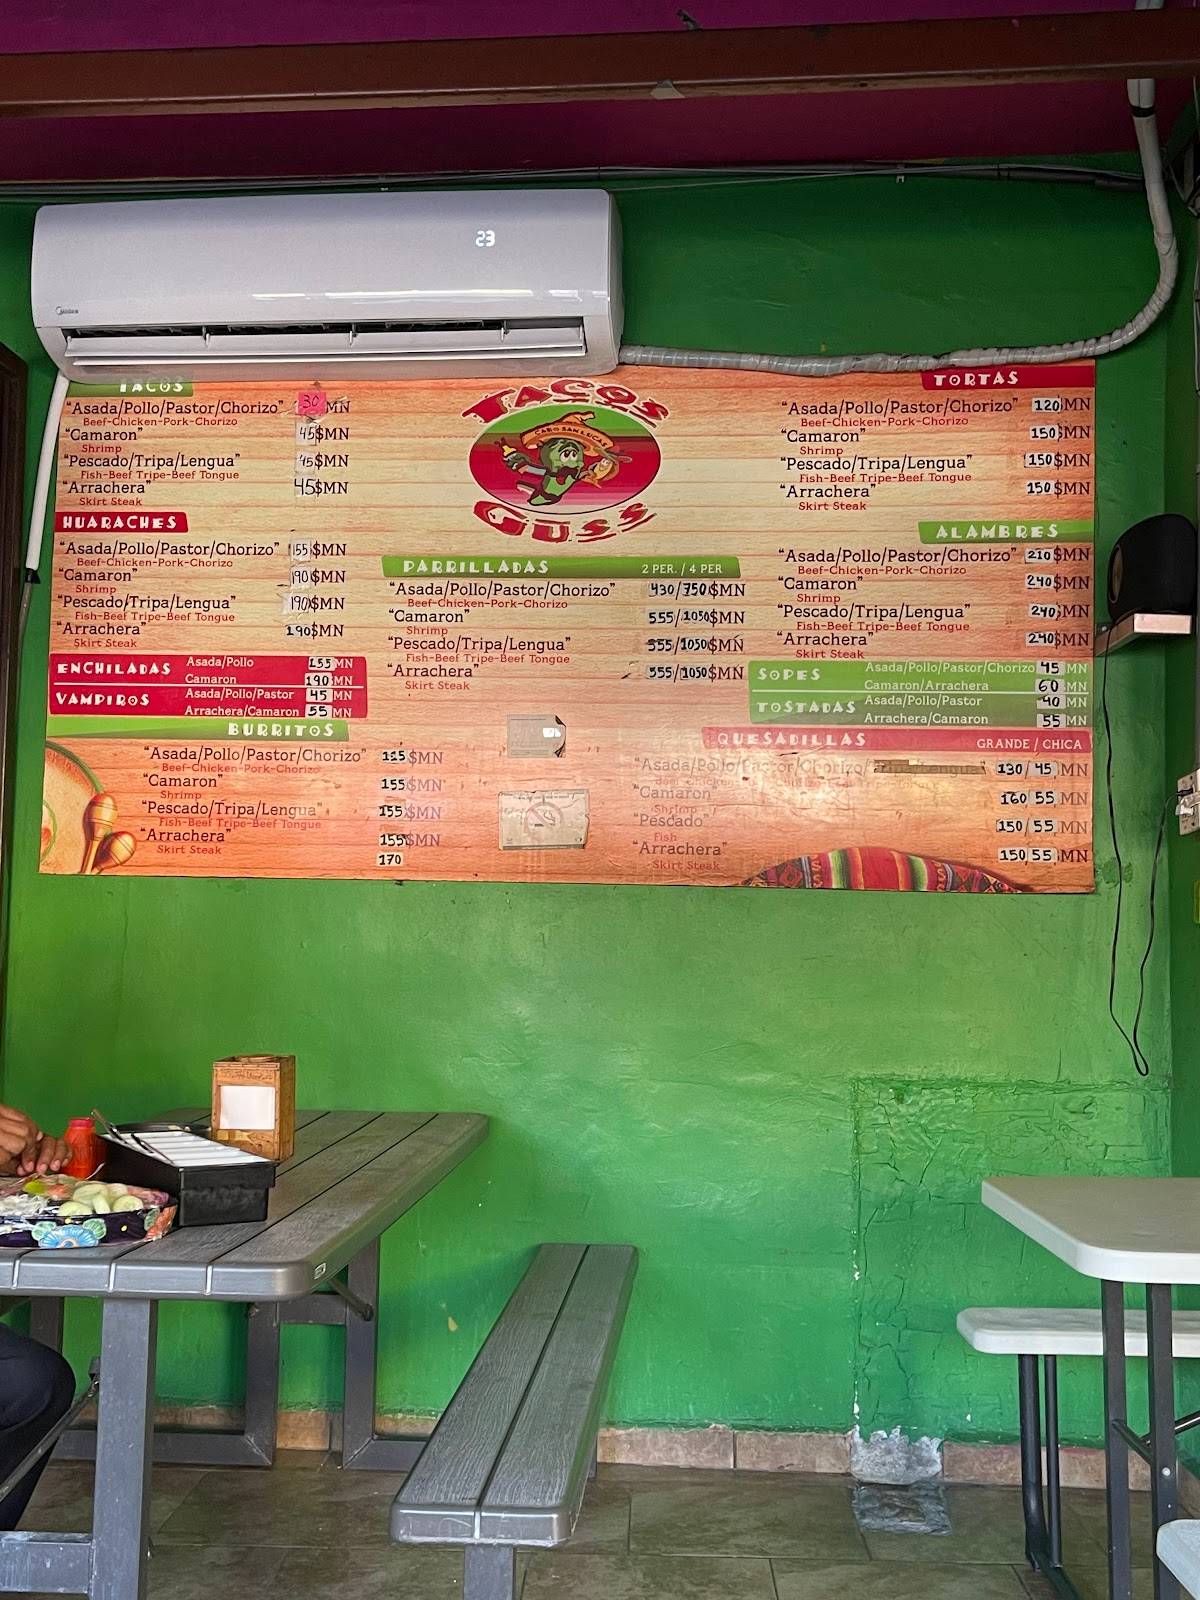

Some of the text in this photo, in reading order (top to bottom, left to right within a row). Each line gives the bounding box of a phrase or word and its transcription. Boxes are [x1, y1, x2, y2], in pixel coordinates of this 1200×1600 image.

[476, 230, 495, 247] 23
[934, 371, 1019, 386] TORTAS
[462, 378, 670, 428] TACOS
[82, 444, 122, 455] Shrimp
[800, 446, 844, 457] Shrimp
[81, 470, 239, 481] Fish-Beef Tripe-Beef Tongue
[800, 473, 972, 484] Fish-Beef Tripe-Beef Tongue
[79, 498, 142, 507] Skirt Steak
[799, 501, 867, 511] Skirt Steak
[63, 515, 178, 530] HUARACHES
[936, 523, 1059, 539] ALAMBRES
[403, 560, 549, 575] PARRILLADAS
[642, 564, 649, 574] 2
[689, 564, 696, 574] 4
[700, 564, 722, 574] PER
[76, 585, 117, 596] Shrimp
[797, 593, 841, 605] Shrimp
[75, 612, 235, 623] Fish-Beef Tripe-Beef Tongue
[406, 625, 448, 637] Shrimp
[797, 622, 970, 633] Fish-Beef Tripe-Beef Tongue
[74, 639, 137, 648] Skirt Steak
[406, 653, 570, 665] Fish-Beef Tripe-Beef Tongue
[795, 649, 864, 659] Skirt Steak
[57, 662, 171, 675] ENCHILADAS
[187, 656, 254, 669] Asada/Pollo
[865, 662, 1035, 675] Asada/Pollo/Pastor/Chorizo
[185, 674, 237, 684] Camaron
[757, 668, 821, 681] SOPES
[405, 681, 470, 690] Skirt Steak
[864, 679, 989, 692] Camaron/Arrachera
[56, 692, 150, 706] VAMPIROS
[185, 687, 294, 700] Asada/Pollo/Pastor
[864, 694, 982, 708] Asada/Pollo/Pastor
[185, 706, 299, 717] Arrachera/Camaron
[757, 701, 856, 714] TOSTADAS
[864, 712, 989, 725] Arrachera/Camaron
[228, 722, 335, 737] BURRITOS
[717, 732, 866, 746] QUESADILLAS
[977, 738, 1029, 749] GRANDE
[1042, 739, 1082, 750] CHICA
[160, 790, 202, 800] Shrimp
[282, 819, 321, 830] Tongue
[654, 833, 677, 841] Fish
[157, 845, 222, 855] Skirt Steak
[687, 860, 720, 870] Steak
